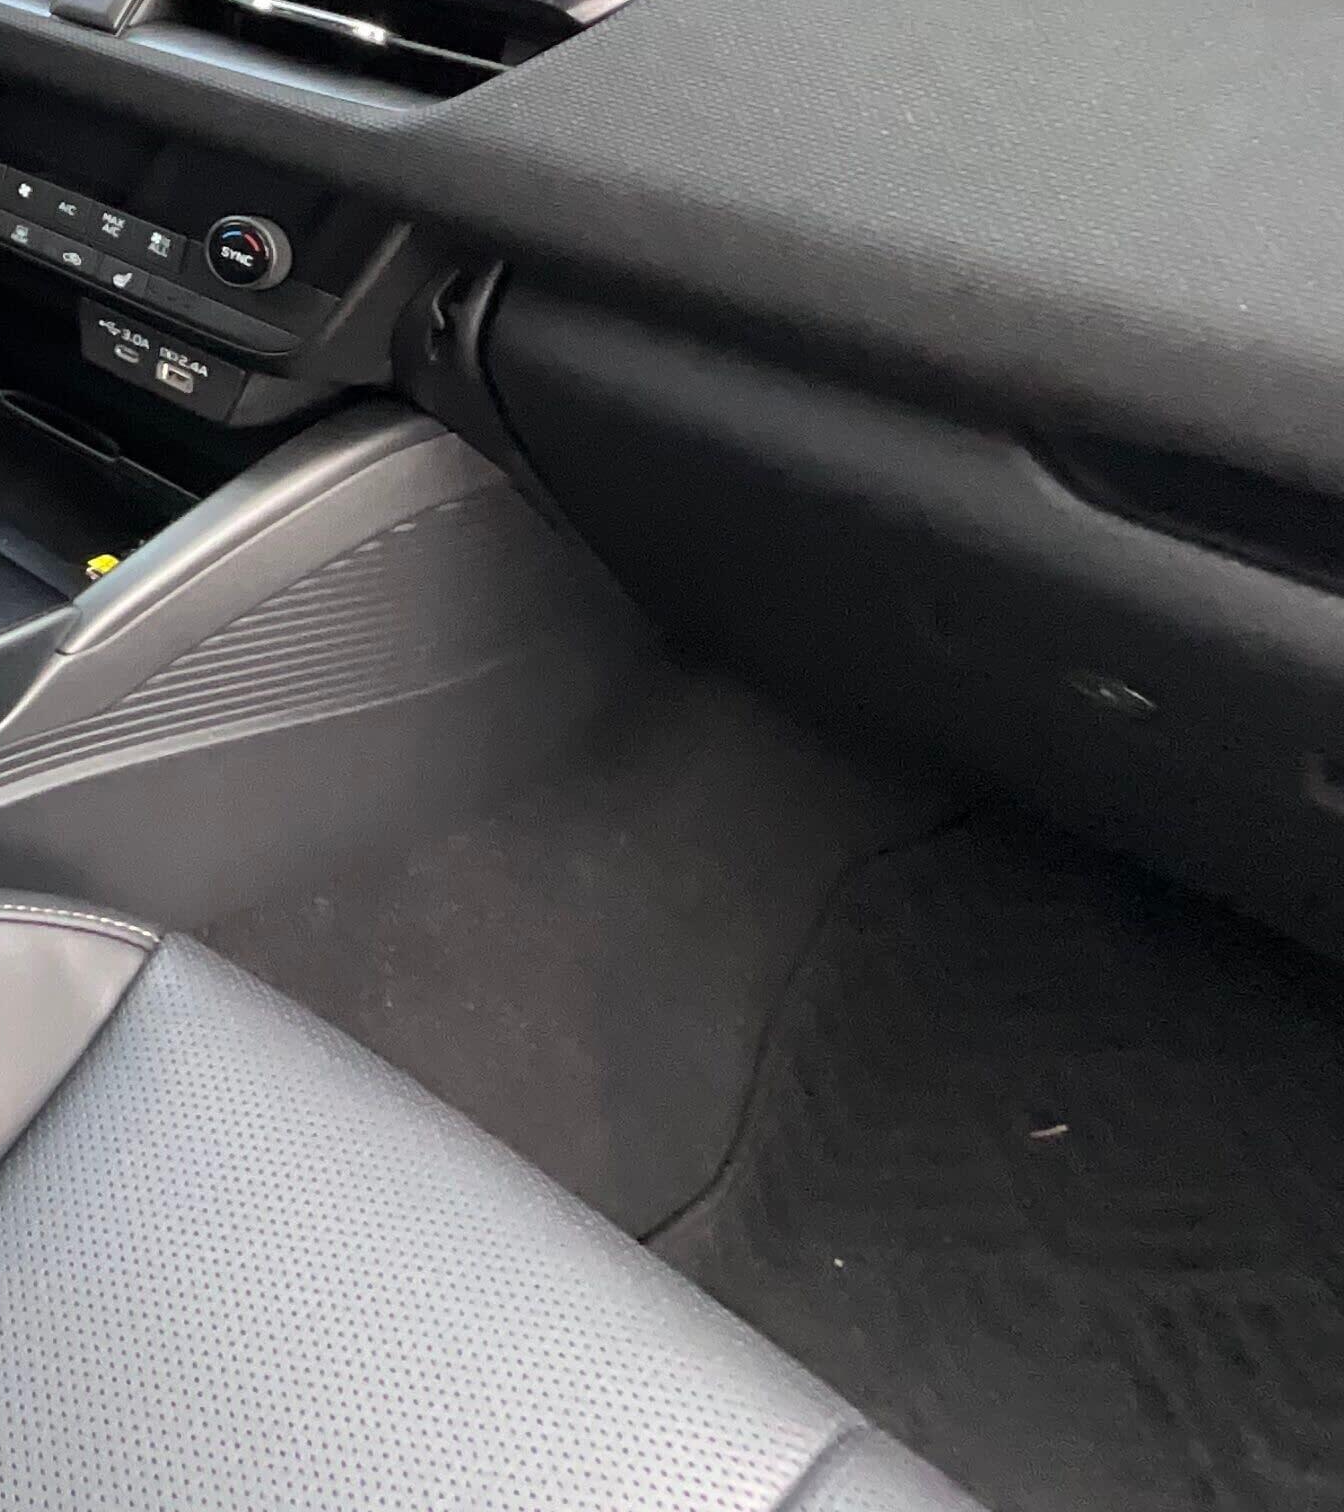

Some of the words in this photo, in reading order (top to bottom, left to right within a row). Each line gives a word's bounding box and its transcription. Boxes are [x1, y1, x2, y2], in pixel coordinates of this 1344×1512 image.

[58, 201, 77, 216] A/C
[102, 212, 125, 228] MAX
[101, 223, 120, 238] A/C
[220, 246, 254, 267] SYNC
[121, 328, 150, 350] 3.0A
[178, 354, 209, 377] 2.4A
